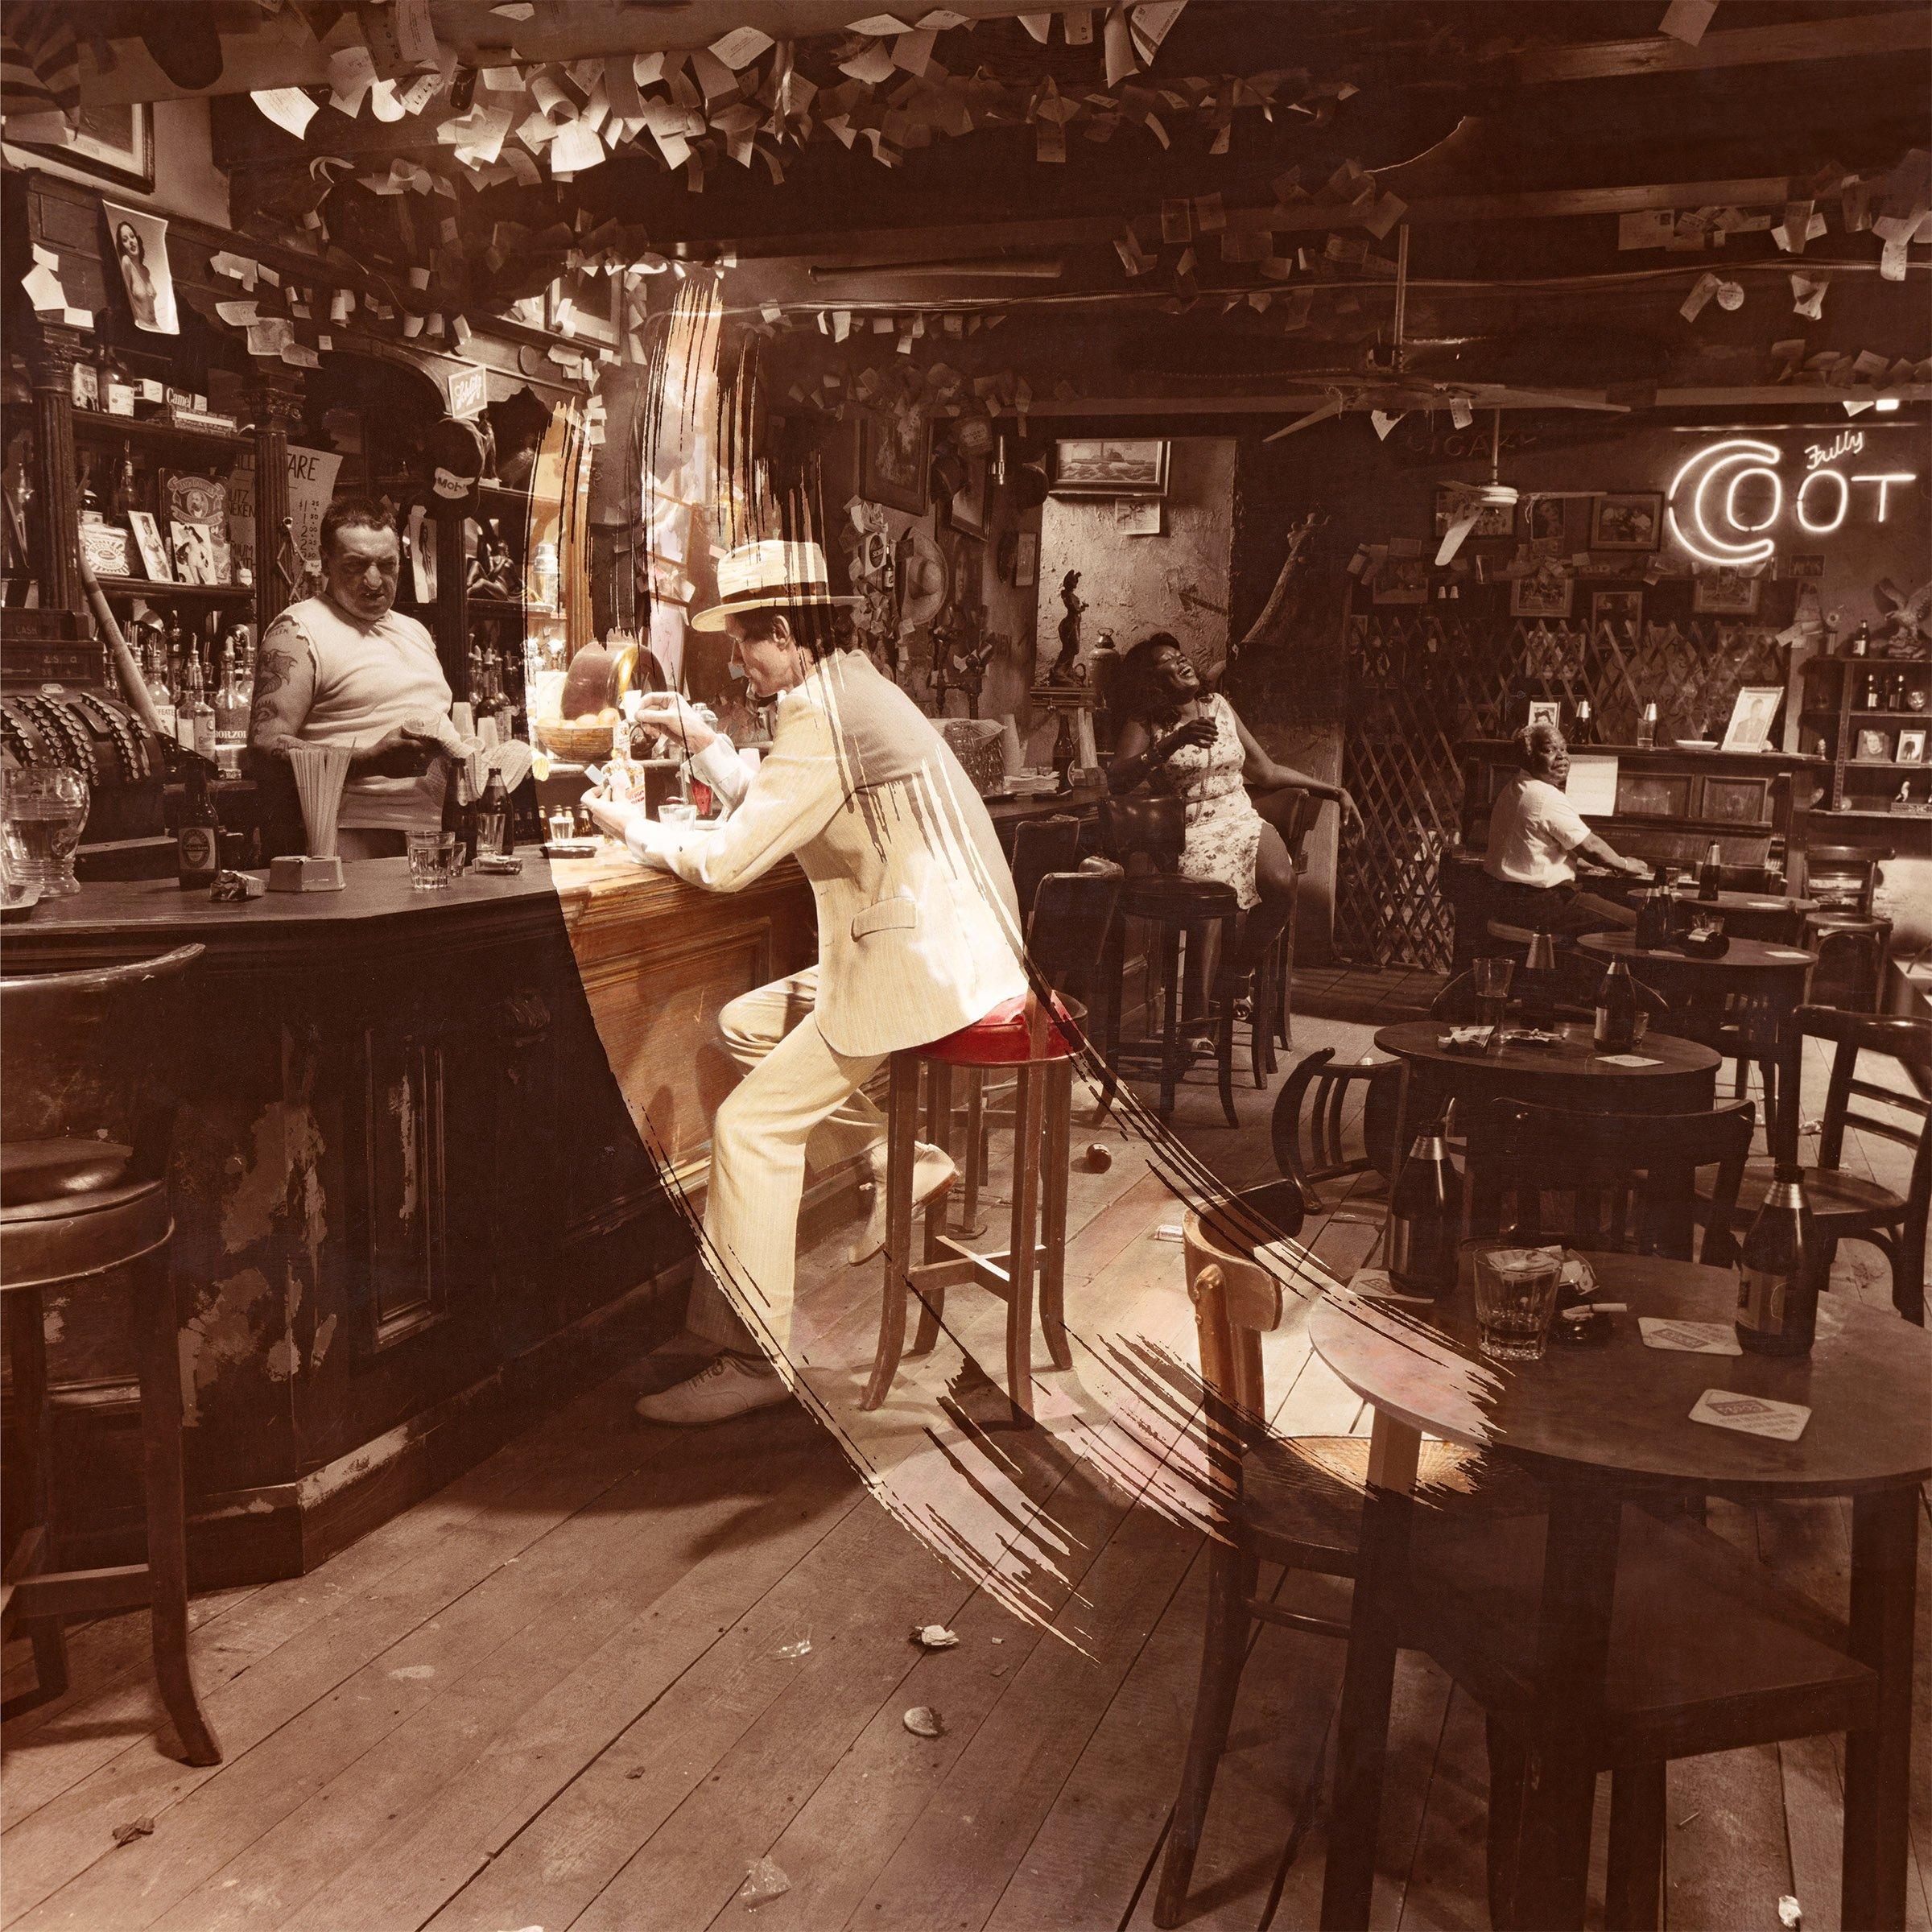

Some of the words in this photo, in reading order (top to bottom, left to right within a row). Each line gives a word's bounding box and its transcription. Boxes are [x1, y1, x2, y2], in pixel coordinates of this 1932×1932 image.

[166, 387, 192, 409] Camel
[1804, 430, 1864, 470] Fully
[287, 452, 320, 481] ARE
